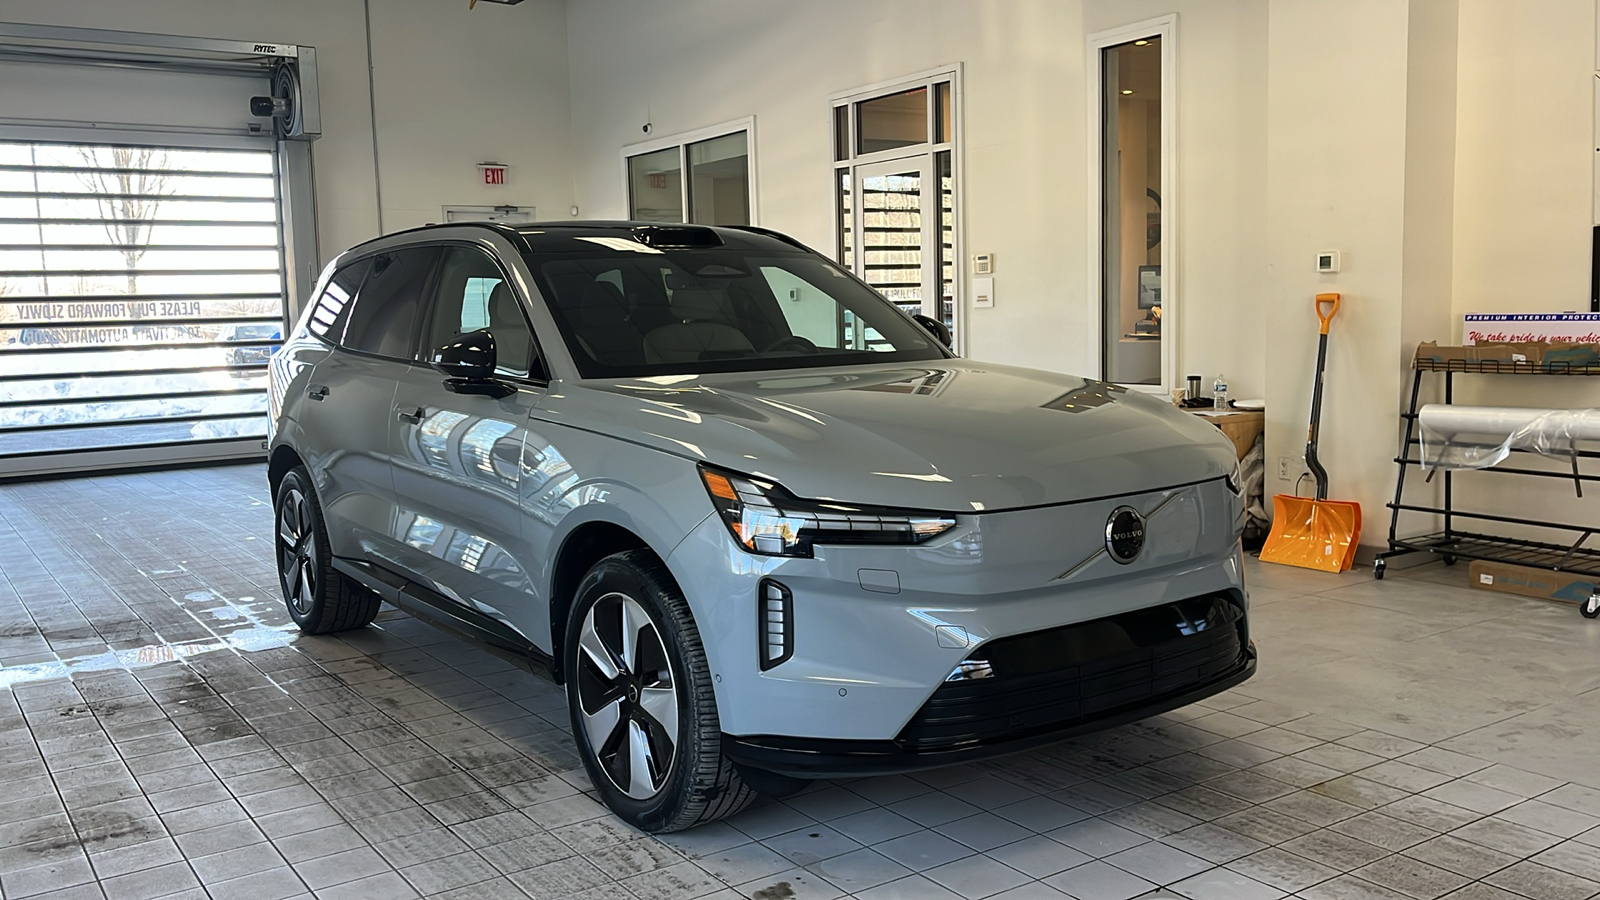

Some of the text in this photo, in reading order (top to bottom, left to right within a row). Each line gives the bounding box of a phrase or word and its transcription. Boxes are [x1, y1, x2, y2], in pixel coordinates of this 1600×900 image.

[253, 44, 277, 54] RYTEC
[484, 167, 505, 185] EXIT
[1469, 331, 1484, 341] We
[1486, 332, 1506, 341] take
[1509, 332, 1536, 342] pride
[1537, 334, 1547, 342] in
[1113, 530, 1143, 541] VOLVO
